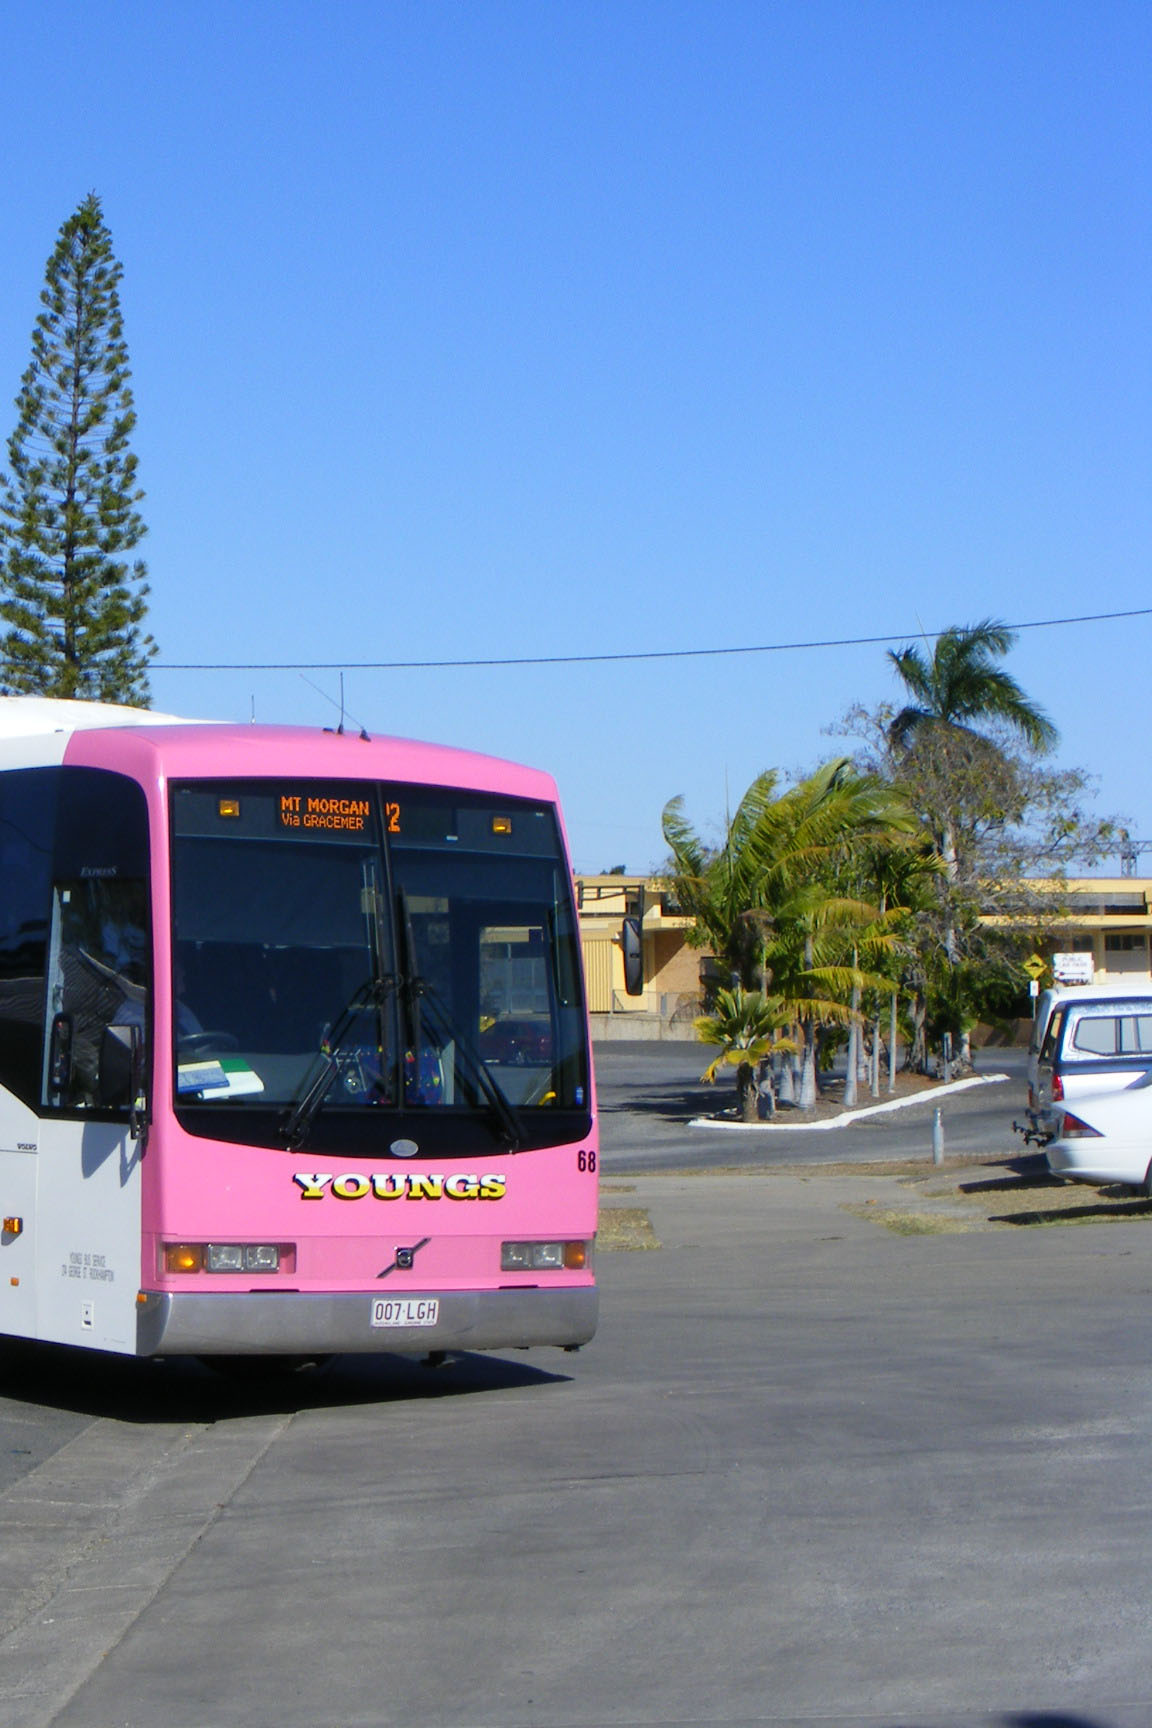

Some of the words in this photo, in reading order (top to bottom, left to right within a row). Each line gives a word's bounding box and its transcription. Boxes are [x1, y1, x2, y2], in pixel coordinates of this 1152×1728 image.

[281, 796, 301, 812] MT
[308, 797, 370, 816] MORGAN
[281, 812, 301, 826] Via
[303, 814, 365, 830] GRACEMER
[577, 1150, 597, 1173] 68
[293, 1173, 507, 1200] YOUNGS
